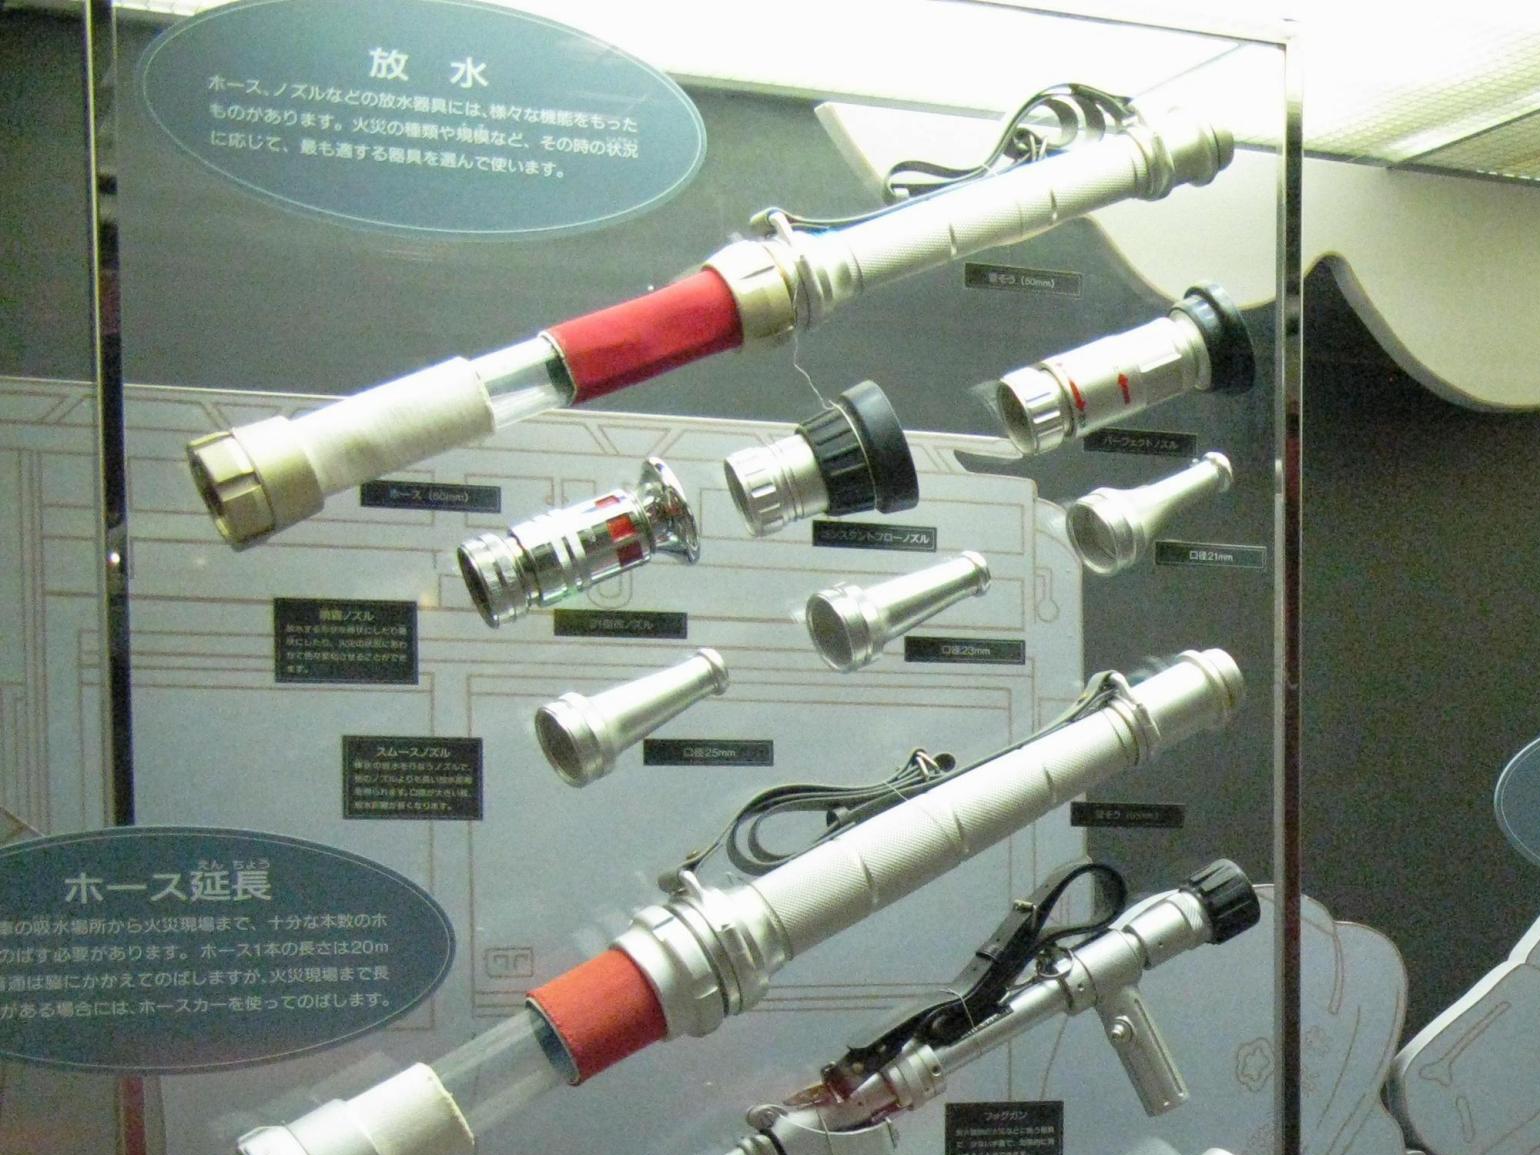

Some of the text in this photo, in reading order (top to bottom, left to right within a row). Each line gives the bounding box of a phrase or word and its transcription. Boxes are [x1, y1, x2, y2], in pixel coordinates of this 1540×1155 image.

[369, 47, 488, 88] 放水
[64, 870, 272, 904] ホース延長
